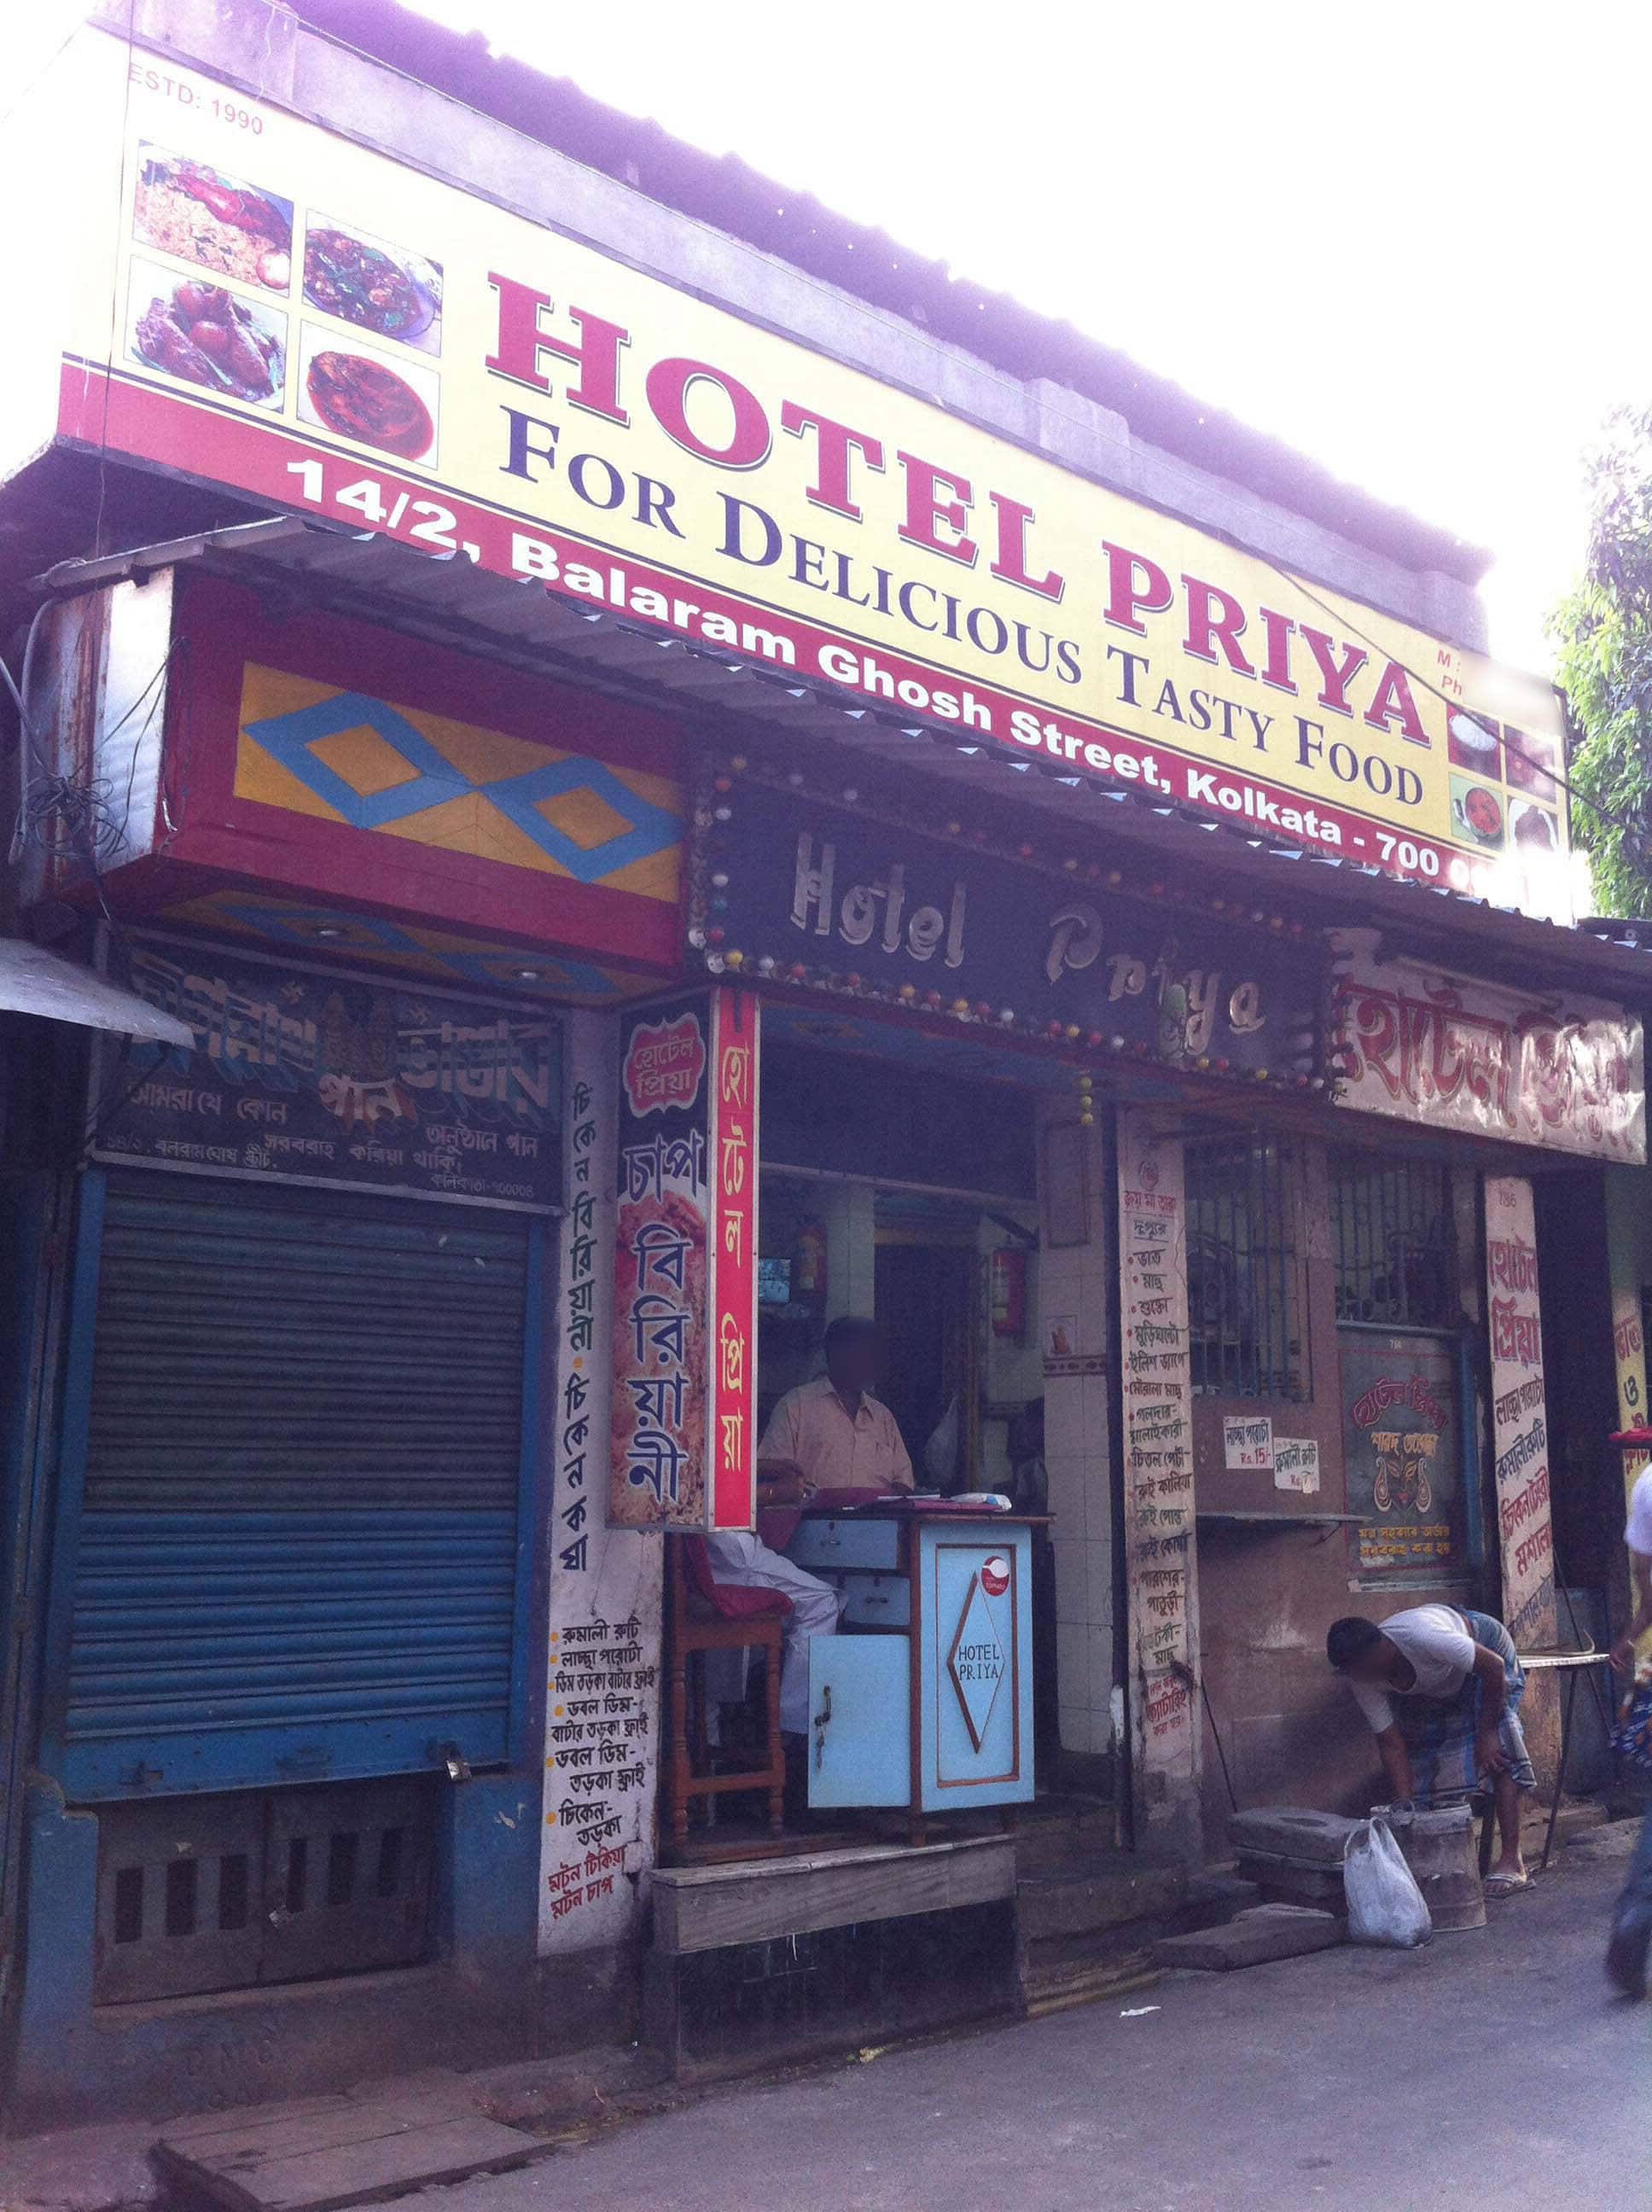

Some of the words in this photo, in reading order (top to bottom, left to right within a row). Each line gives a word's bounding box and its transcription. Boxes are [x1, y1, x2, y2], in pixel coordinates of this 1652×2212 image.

[212, 99, 264, 135] 1990
[485, 271, 1064, 605] HOTEL
[1102, 540, 1432, 749] PRIYA
[500, 405, 686, 539] FOR
[715, 492, 1081, 684] DELICIOUS
[1108, 644, 1274, 753] TASTY
[1294, 715, 1423, 806] FOOD
[287, 458, 480, 564] 14/2,
[512, 532, 796, 665] Balaram
[818, 644, 992, 731] Ghosh
[1010, 711, 1172, 795] Street,
[1188, 769, 1341, 846] Kolkata
[1376, 833, 1439, 876] 700
[791, 833, 966, 968] Hotel
[636, 1035, 695, 1069] হোটেল
[622, 1127, 705, 1203] চাপ
[957, 1644, 1000, 1662] HOTEL
[959, 1662, 999, 1681] PRIYA
